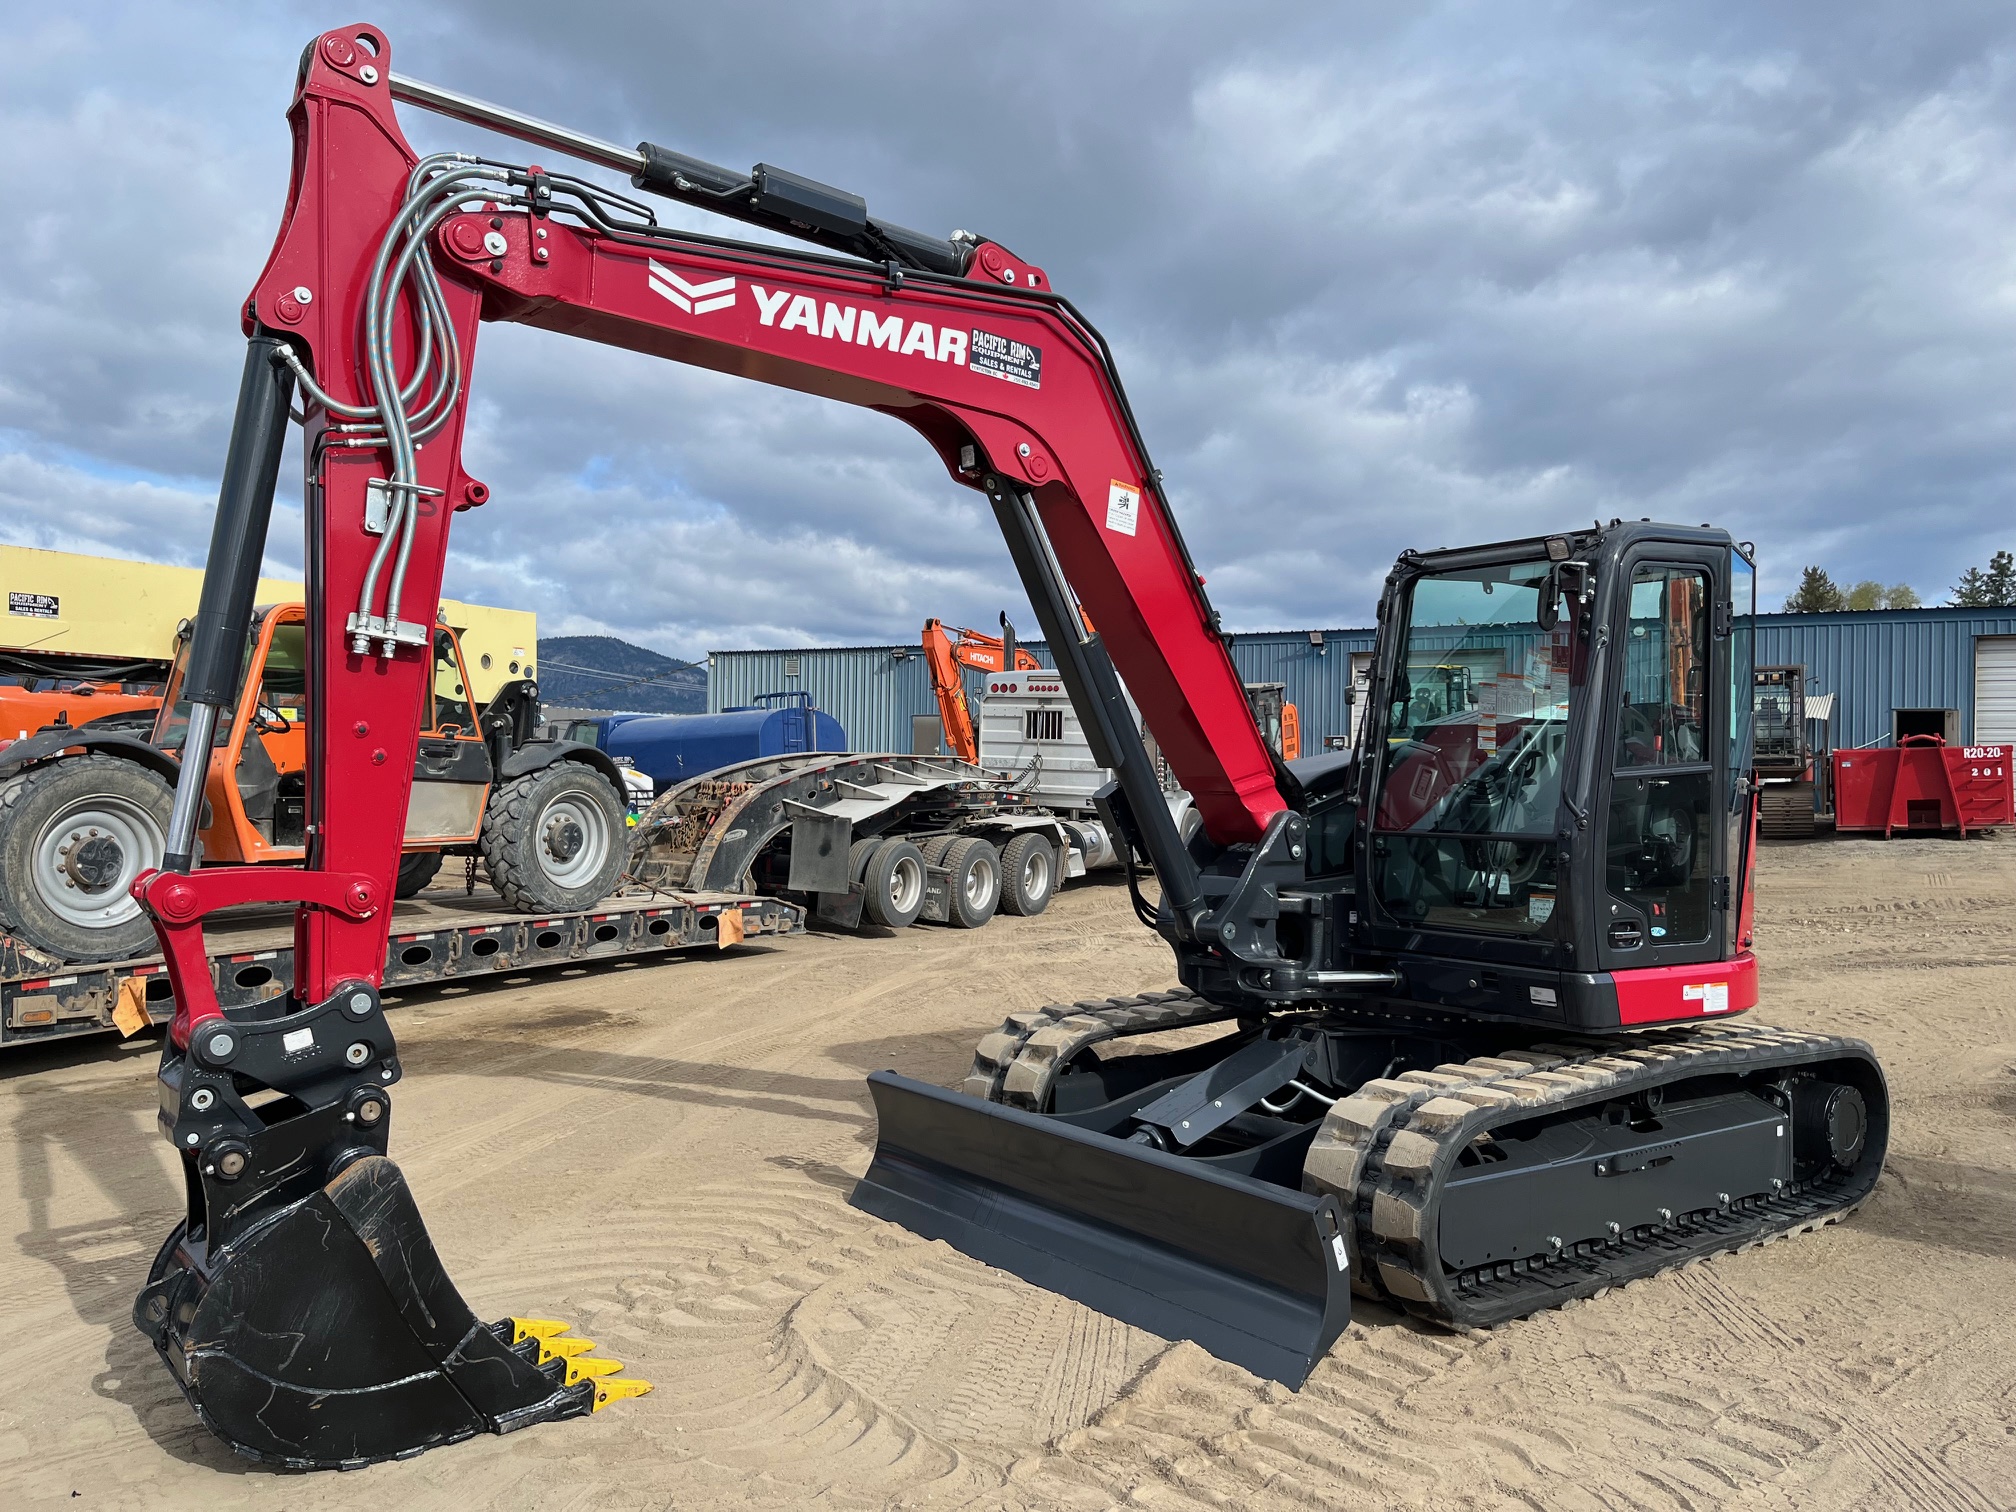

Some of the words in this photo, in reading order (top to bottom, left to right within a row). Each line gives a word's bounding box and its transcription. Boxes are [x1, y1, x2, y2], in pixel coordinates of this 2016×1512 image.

[750, 284, 968, 366] YANMAR
[971, 344, 1025, 366] EQUIPMENT
[972, 329, 1007, 354] PACIFIC
[1010, 341, 1027, 360] RIM
[979, 356, 998, 369] SALES
[999, 362, 1005, 371] &
[1006, 364, 1032, 379] RENTALS
[10, 592, 34, 603] PACIFIC
[36, 595, 48, 604] RIM
[970, 651, 994, 665] HITACHI
[926, 887, 942, 895] AND
